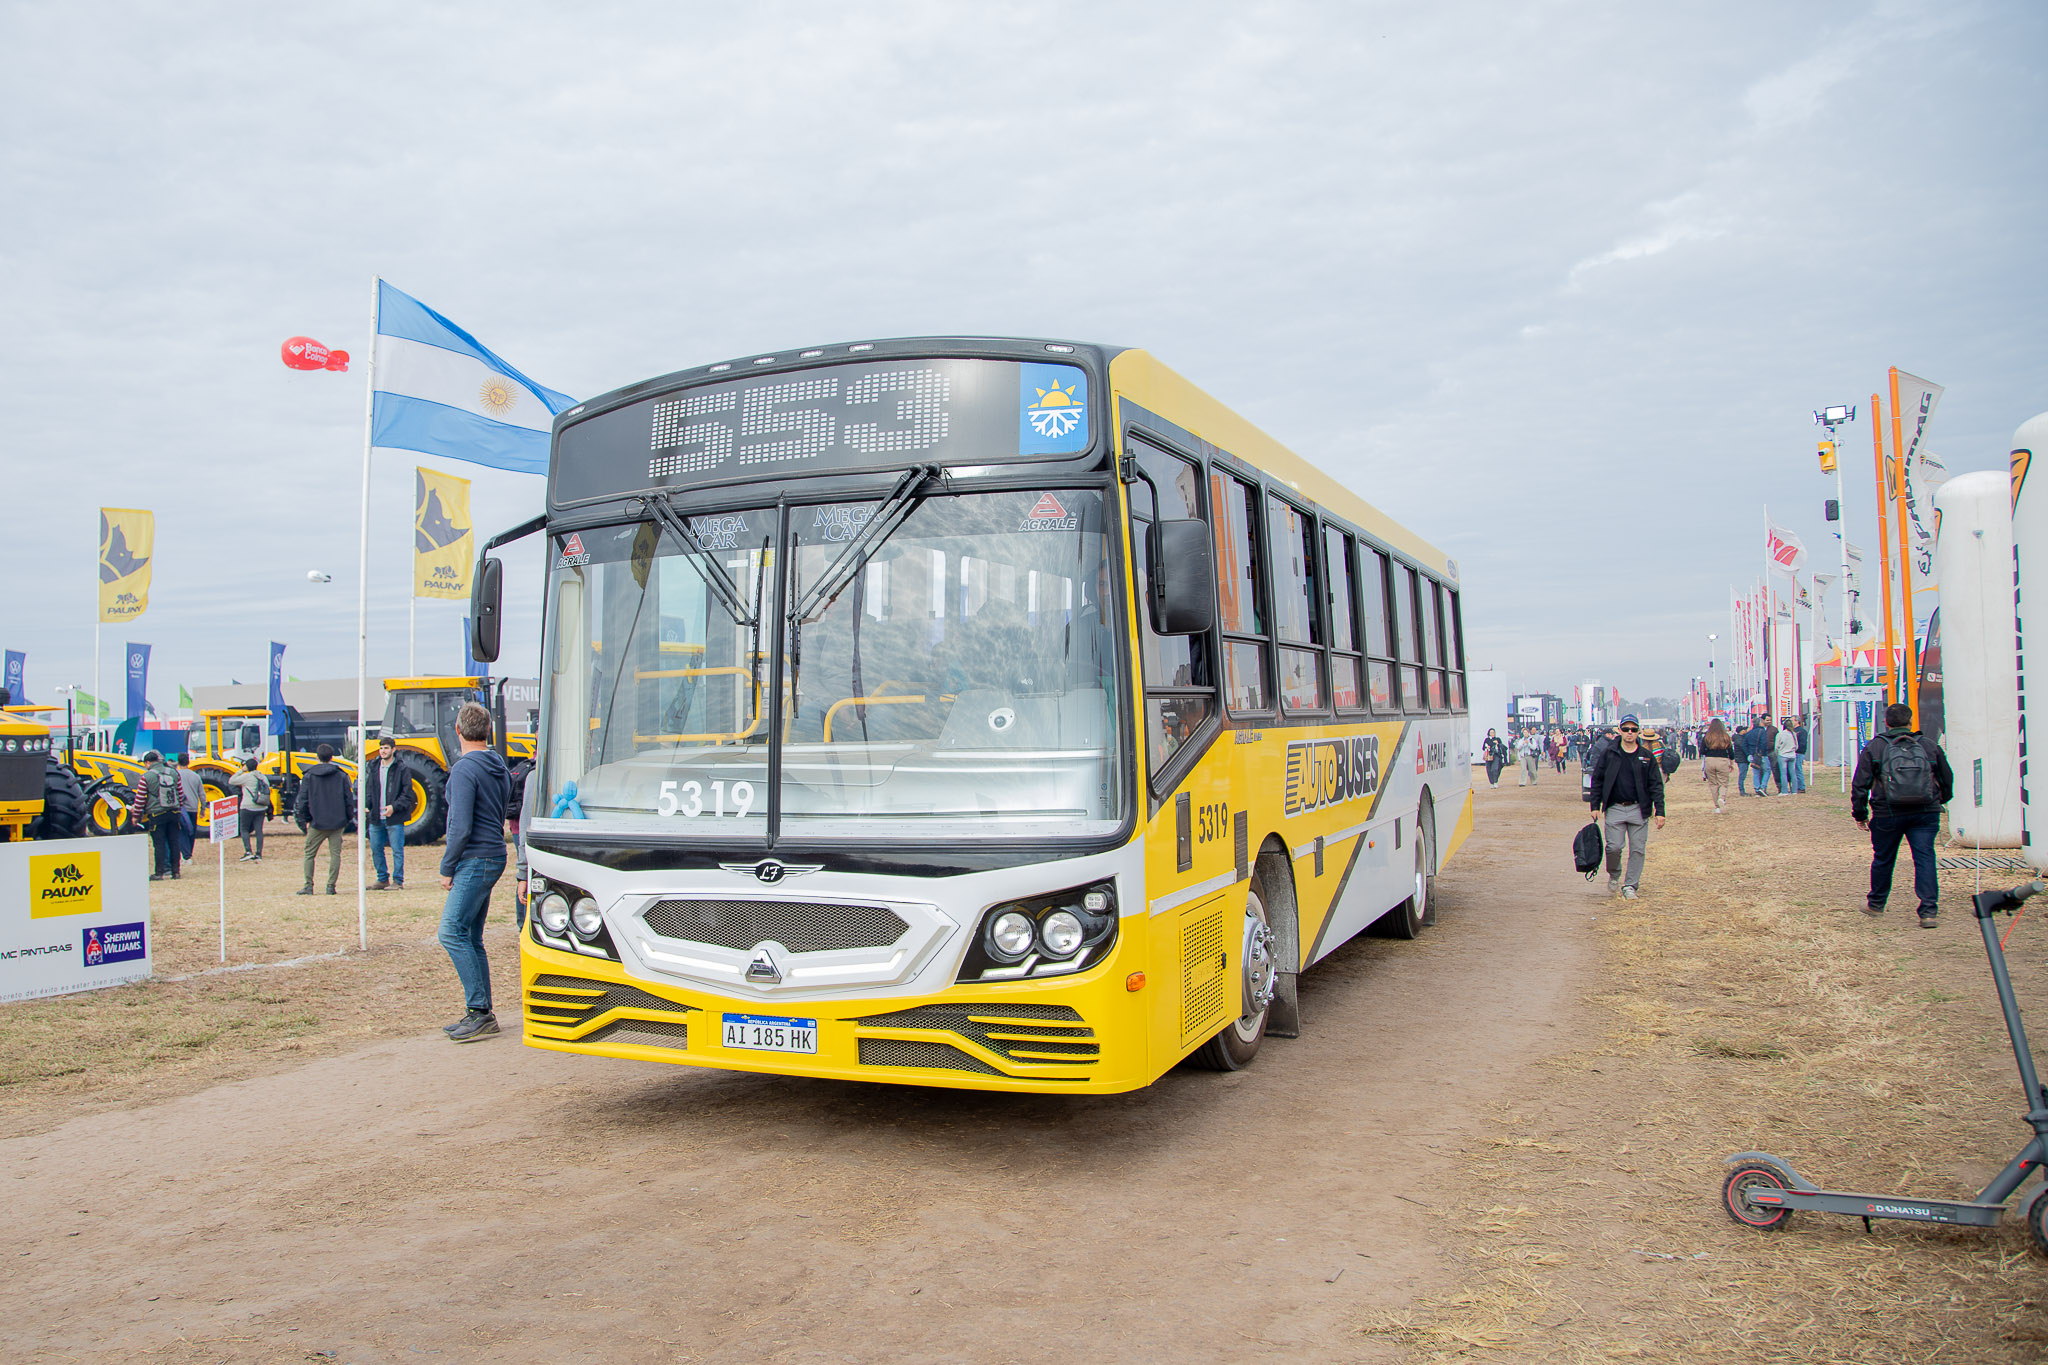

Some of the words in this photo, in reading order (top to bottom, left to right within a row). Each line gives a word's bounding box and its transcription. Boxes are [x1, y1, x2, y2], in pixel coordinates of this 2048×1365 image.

[649, 369, 950, 478] 553
[812, 504, 883, 527] MEGA
[1018, 518, 1078, 531] AGRALE
[687, 515, 749, 537] MEGA
[824, 522, 871, 542] CAR
[696, 531, 738, 551] CAR
[556, 553, 590, 569] AGRALE
[424, 580, 464, 591] PAUNY
[107, 604, 142, 614] PAUNY
[1782, 667, 1791, 696] Drones
[492, 685, 540, 701] VENI
[1427, 742, 1446, 772] AGRALE
[1284, 734, 1380, 818] AUTOBUSES
[657, 780, 755, 818] 5319
[1198, 801, 1228, 844] 5319
[41, 884, 94, 900] PAUNY
[104, 930, 141, 943] SHERWIN
[0, 950, 18, 960] MC
[20, 943, 73, 957] PINTURAS
[25, 989, 38, 997] del
[92, 979, 108, 987] bien
[727, 1025, 746, 1044] AI
[753, 1027, 785, 1047] 185
[791, 1029, 812, 1049] HK
[1875, 1204, 1930, 1216] DAIHATSU
